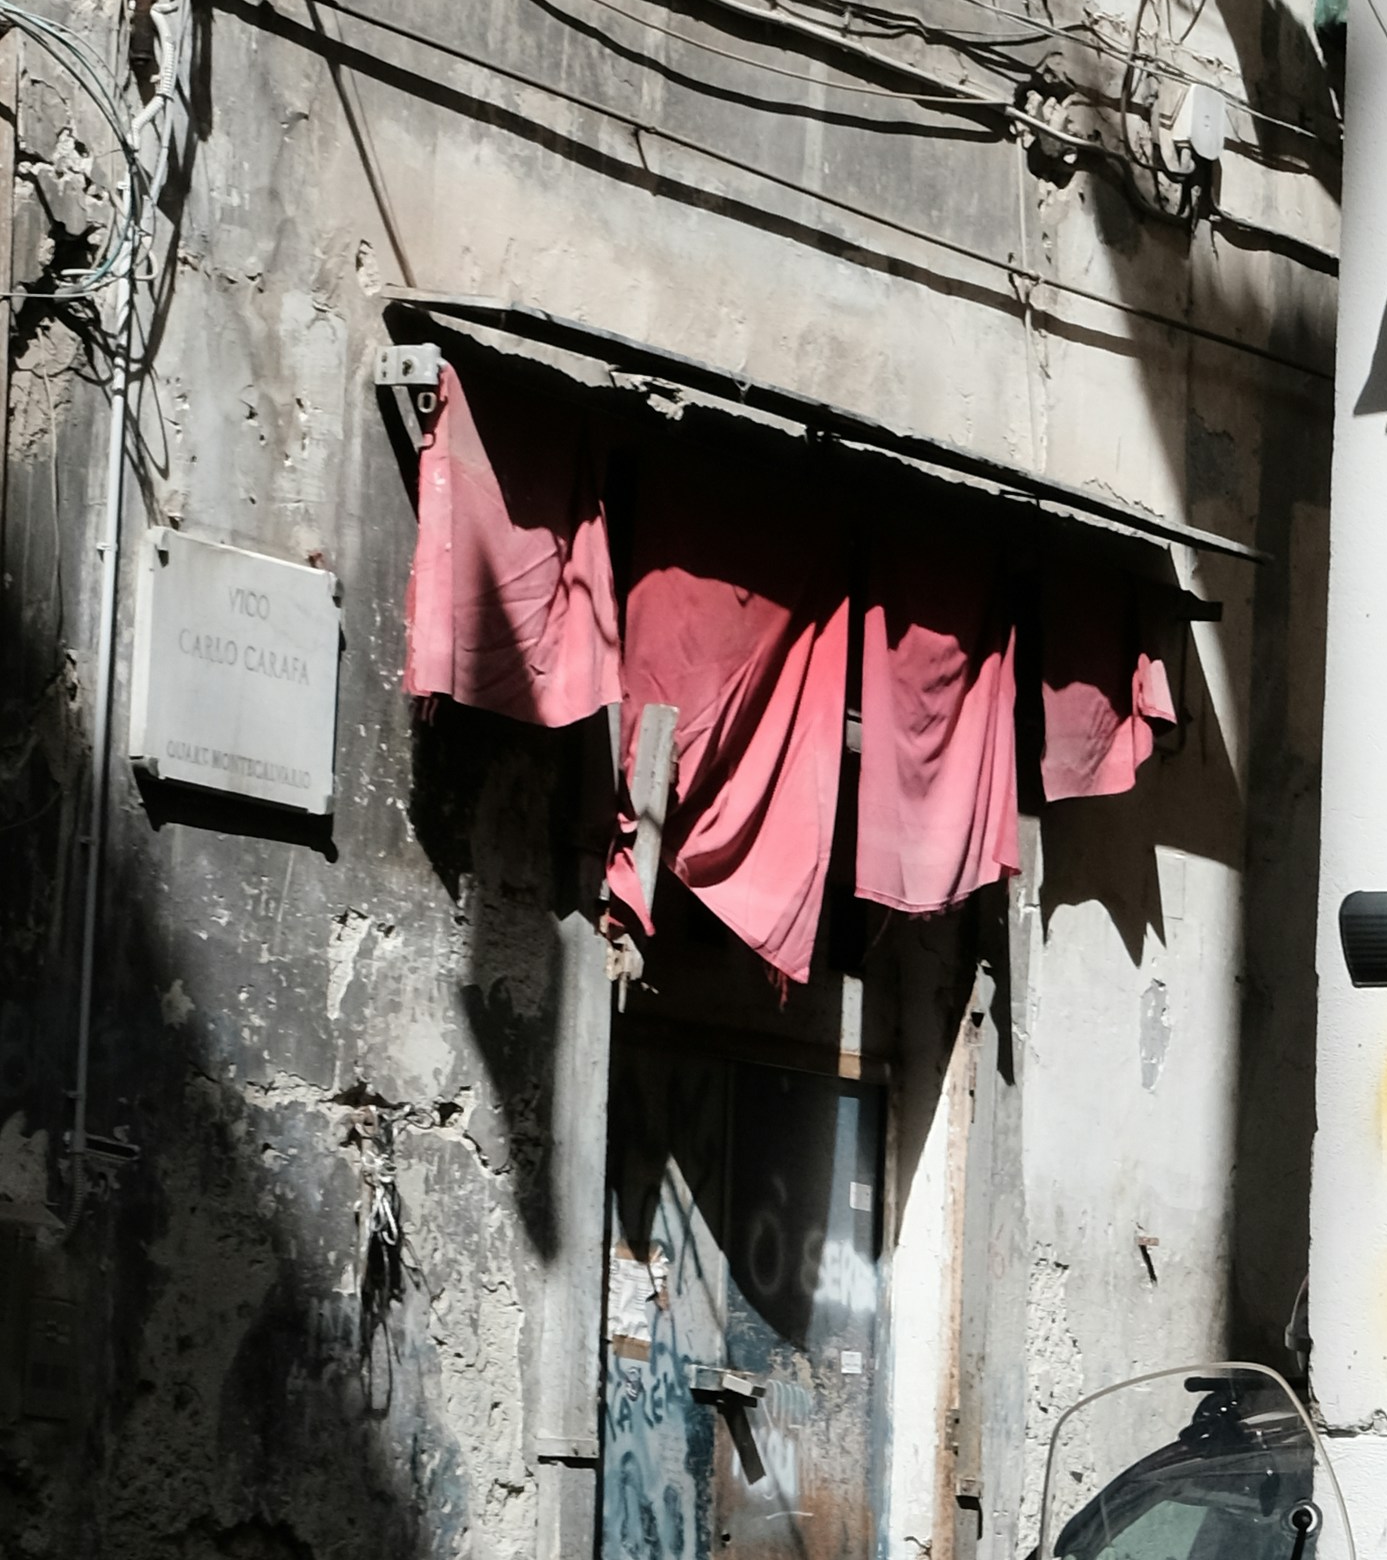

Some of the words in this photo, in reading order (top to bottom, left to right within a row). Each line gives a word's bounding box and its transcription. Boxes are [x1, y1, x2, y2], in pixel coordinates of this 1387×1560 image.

[228, 586, 271, 621] VICO
[178, 627, 238, 667] CARLO
[243, 645, 311, 686] CARAFA
